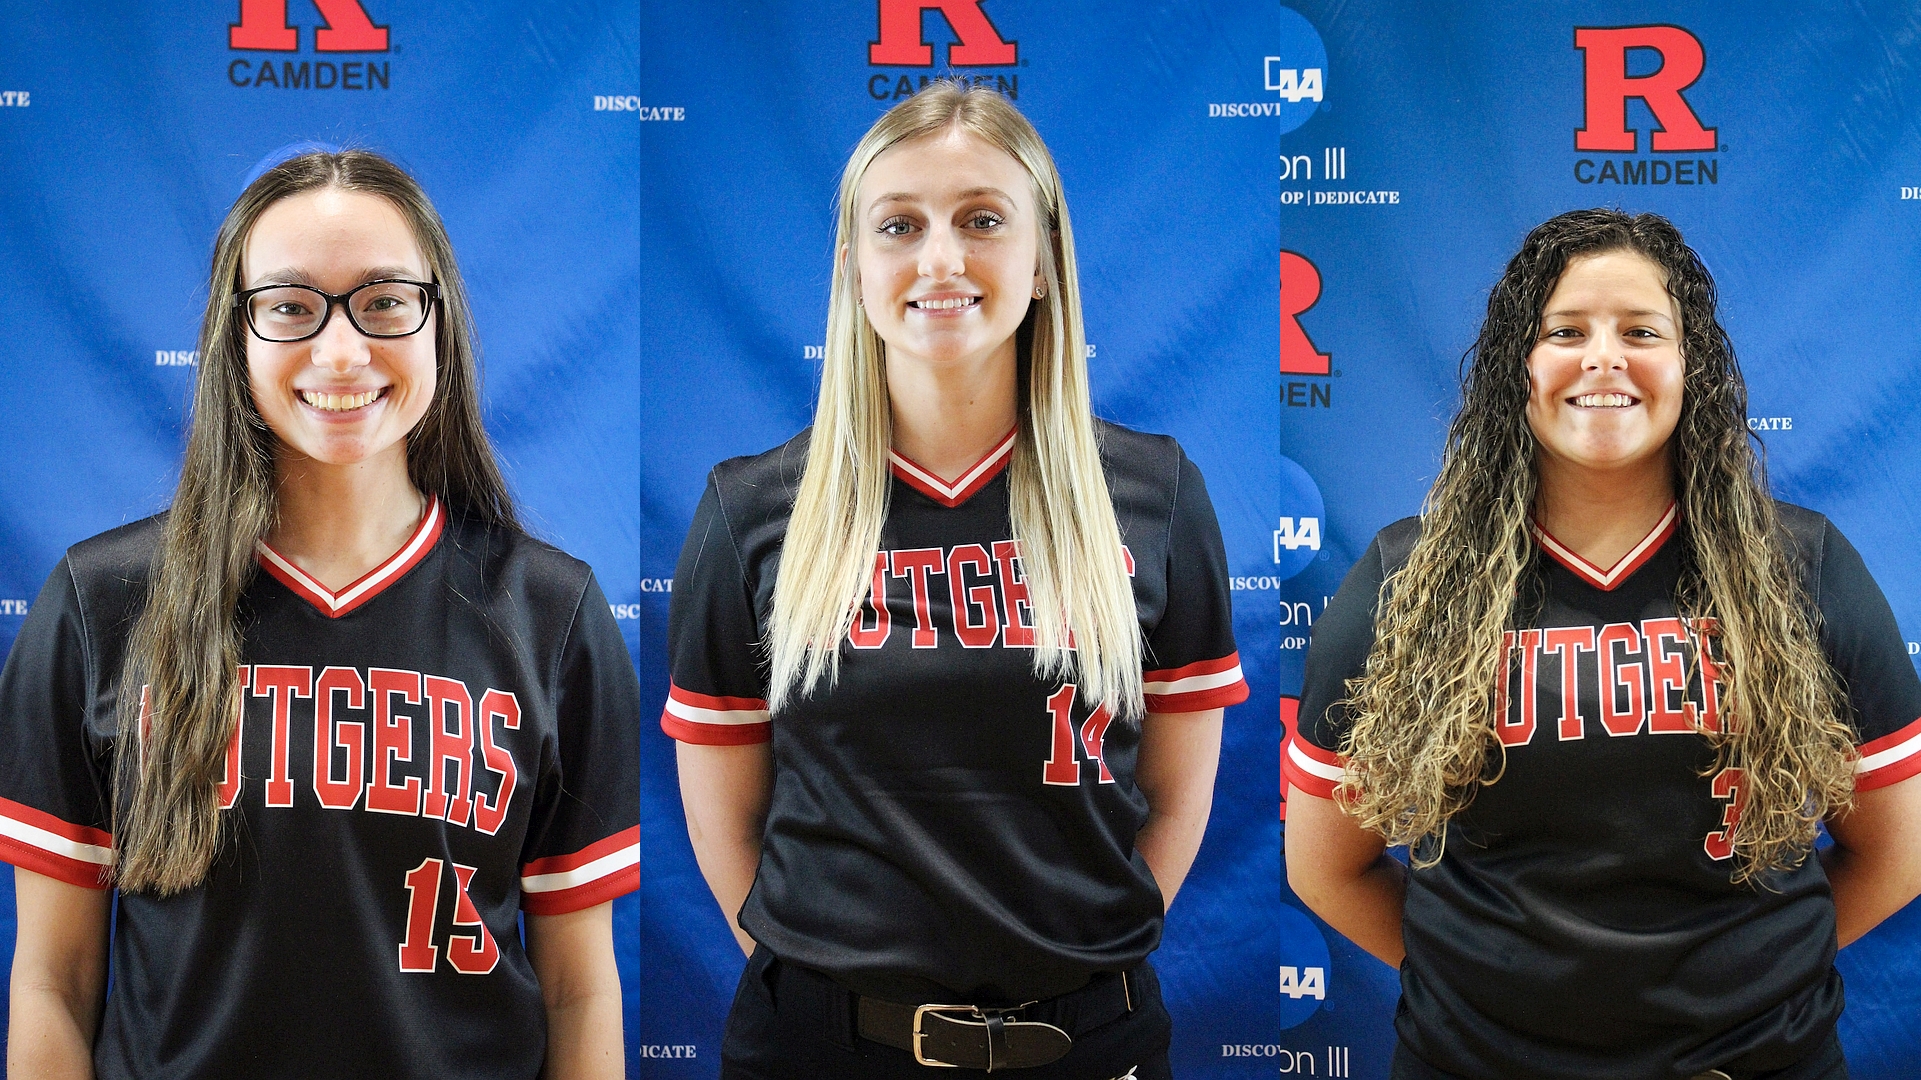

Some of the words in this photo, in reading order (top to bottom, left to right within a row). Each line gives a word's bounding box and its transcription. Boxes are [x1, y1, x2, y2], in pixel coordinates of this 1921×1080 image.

[228, 59, 389, 90] CAMDEN
[1573, 23, 1718, 153] R
[594, 95, 640, 112] DISC
[640, 107, 685, 121] CATE
[1574, 159, 1718, 185] CAMDEN
[1315, 191, 1399, 205] DEDICATE
[1901, 186, 1921, 200] DI
[1280, 382, 1331, 408] EN
[1747, 417, 1792, 431] CATE
[0, 599, 28, 615] TE
[1042, 683, 1118, 786] 14
[398, 857, 501, 974] 15
[640, 1045, 697, 1059] ICATE
[1221, 1044, 1280, 1058] DISCO
